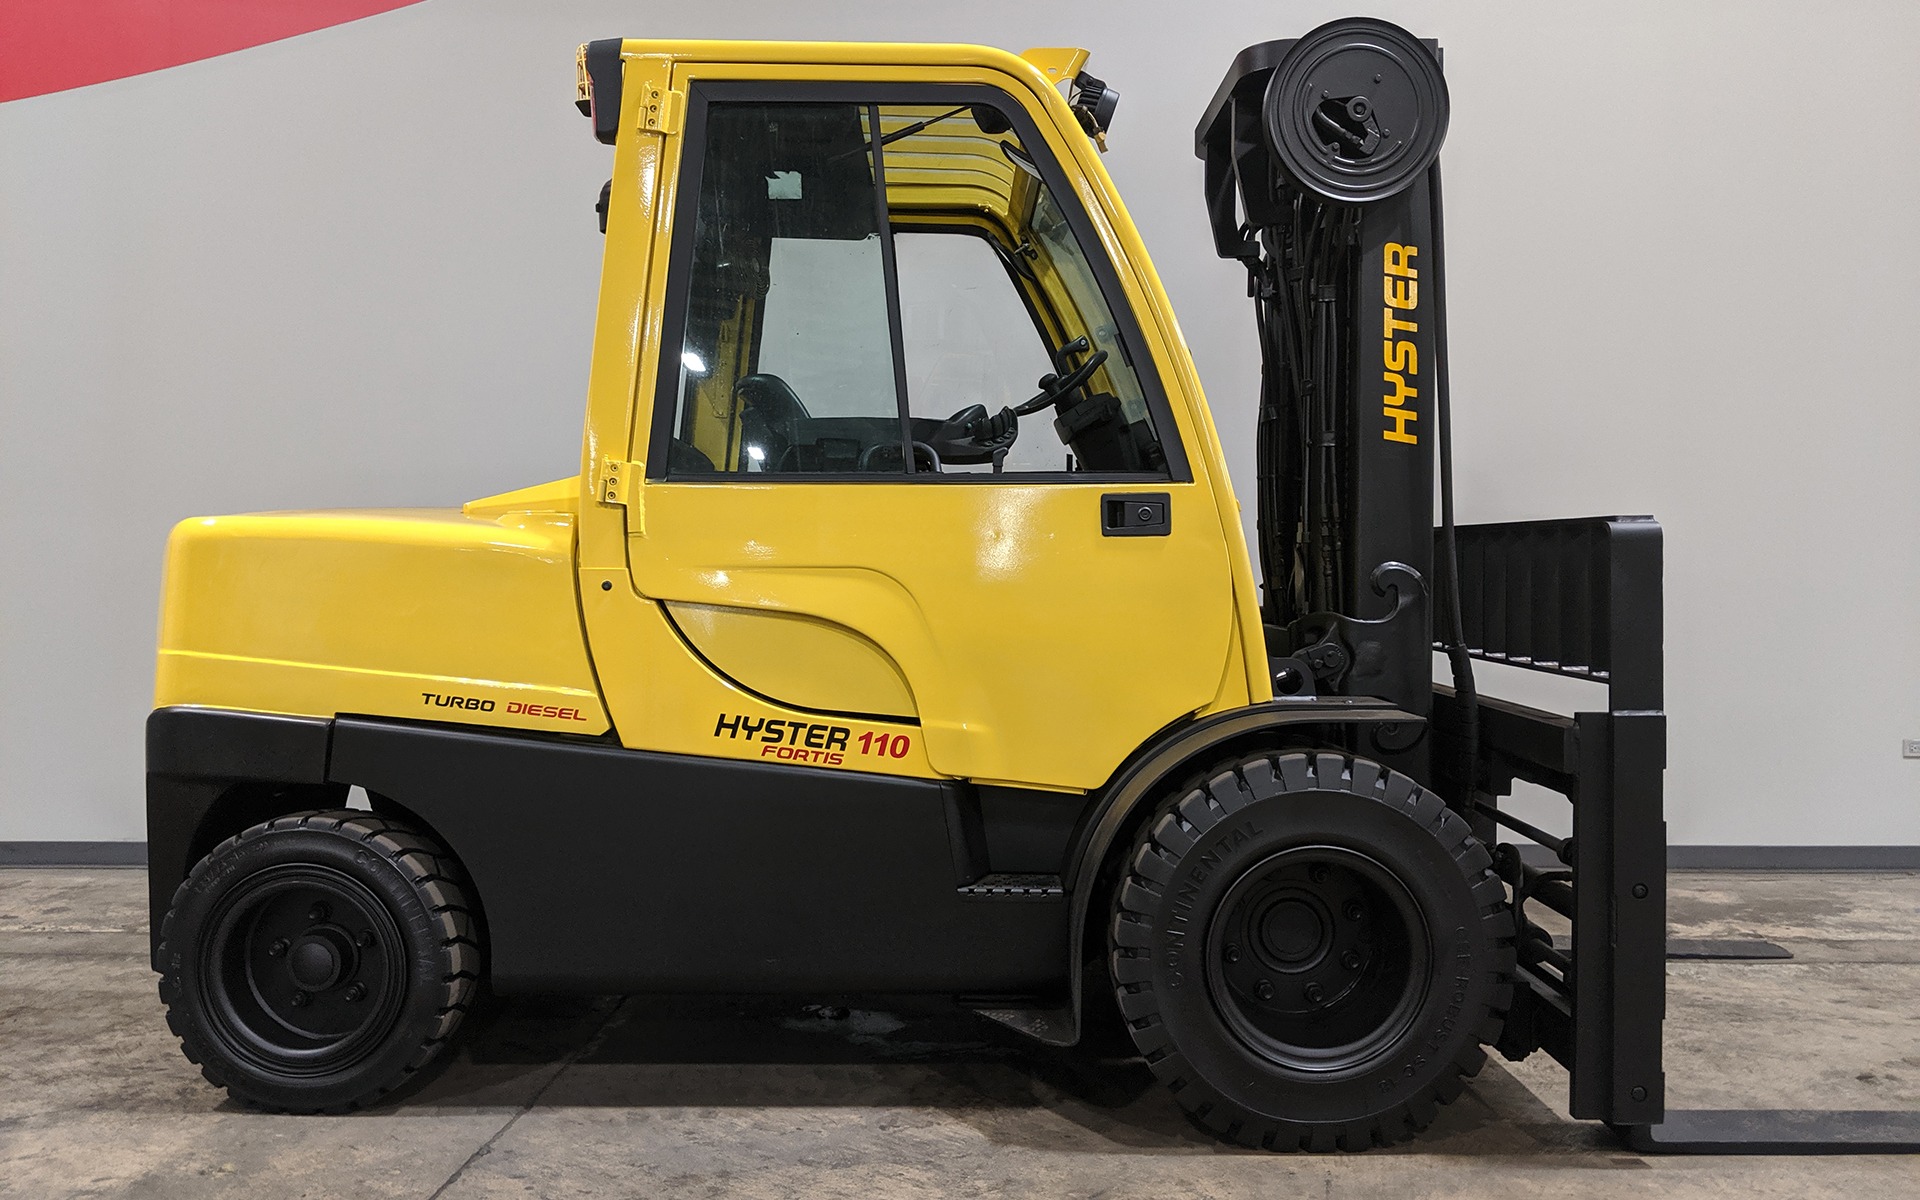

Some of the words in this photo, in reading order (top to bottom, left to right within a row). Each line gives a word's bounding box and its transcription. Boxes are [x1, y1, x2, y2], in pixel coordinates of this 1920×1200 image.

[1383, 242, 1418, 444] HYSTER
[422, 693, 495, 711] TURBO
[505, 701, 588, 721] DIESEL
[714, 713, 850, 751] HYSTER
[858, 731, 910, 759] 110
[761, 746, 843, 765] FORTIS
[1165, 819, 1263, 991] CONTINENTAL
